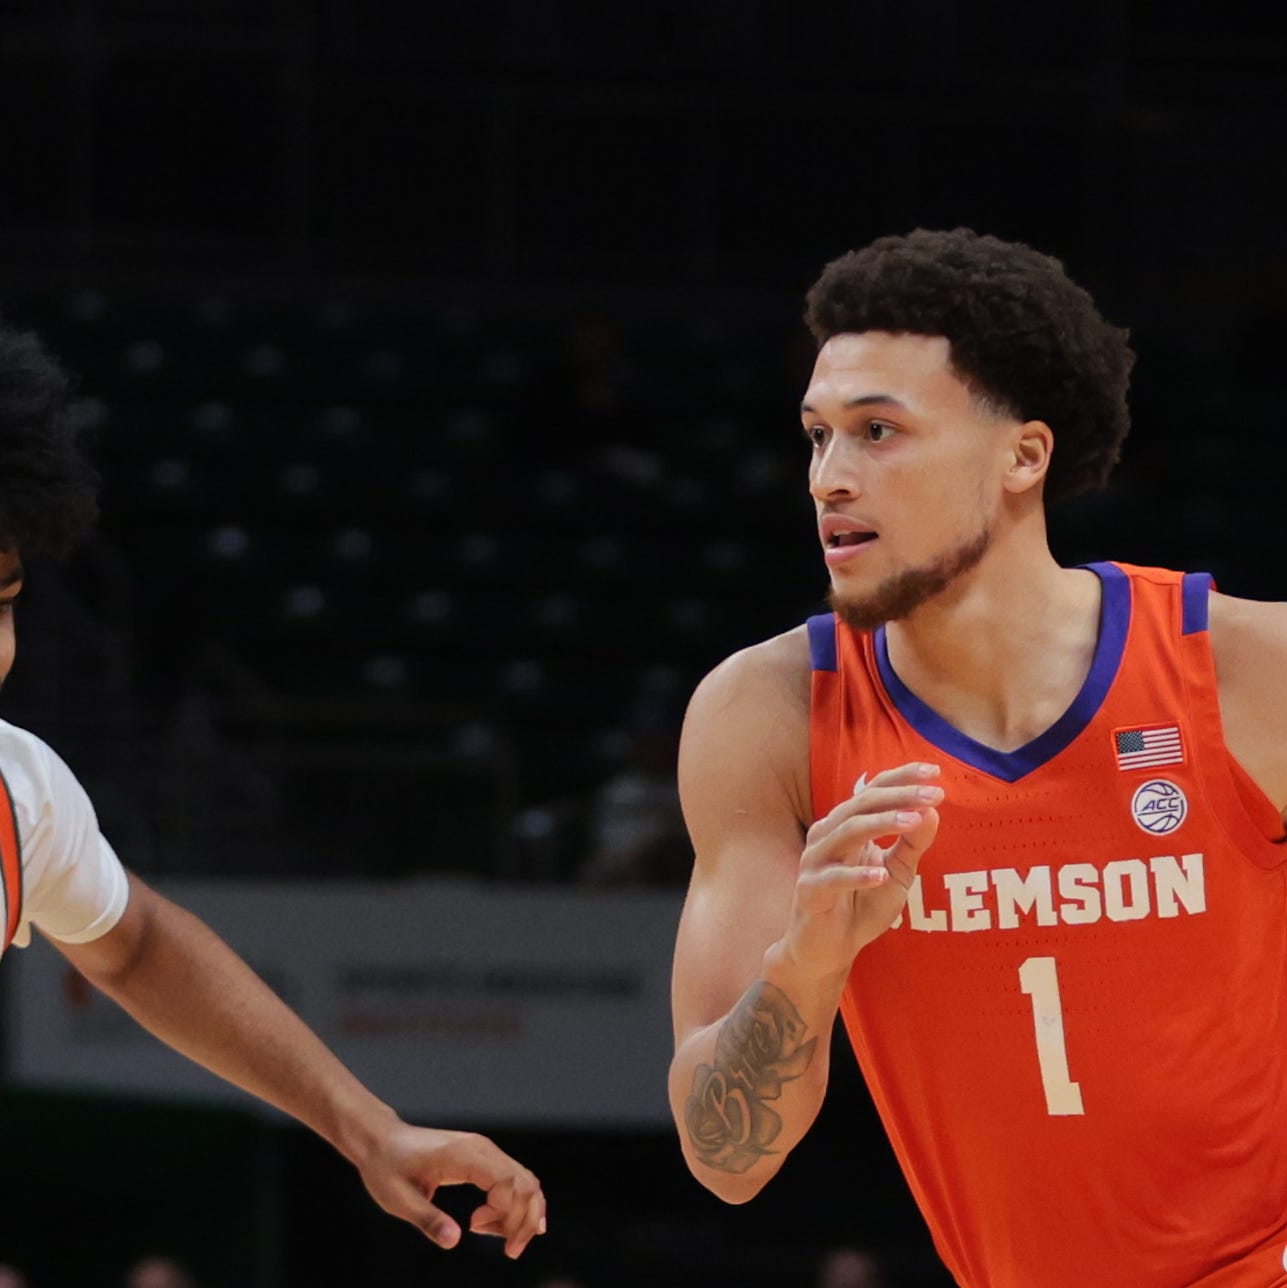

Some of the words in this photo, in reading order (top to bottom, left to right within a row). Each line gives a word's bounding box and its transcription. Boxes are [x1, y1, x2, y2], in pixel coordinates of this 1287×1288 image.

[1142, 795, 1180, 812] ACC
[890, 853, 1207, 933] LEMSON
[1018, 957, 1085, 1116] 1
